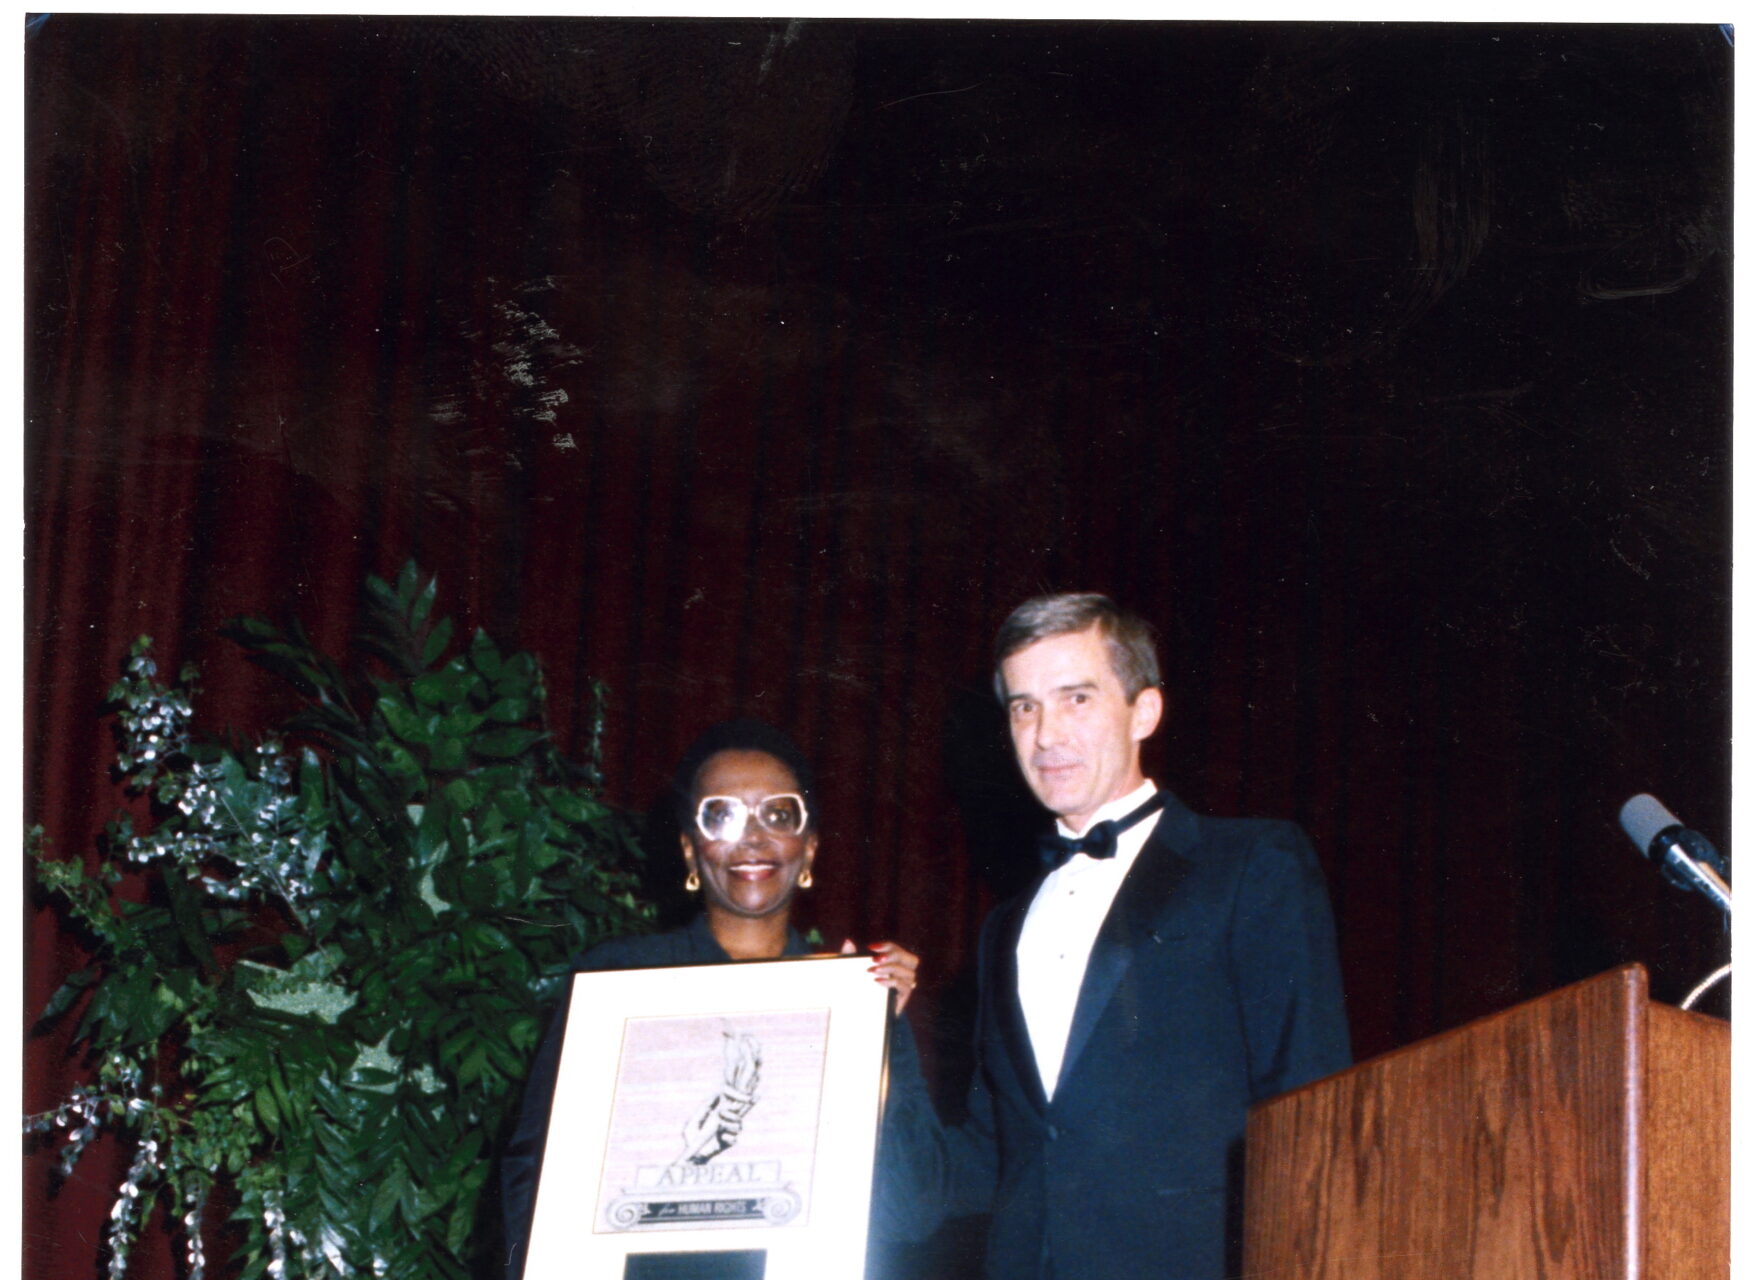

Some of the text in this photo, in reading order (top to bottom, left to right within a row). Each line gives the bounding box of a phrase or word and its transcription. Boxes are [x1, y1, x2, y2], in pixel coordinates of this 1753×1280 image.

[656, 1163, 761, 1186] APPEAL
[677, 1202, 712, 1215] HUMAN
[714, 1200, 747, 1214] RIGHTS
